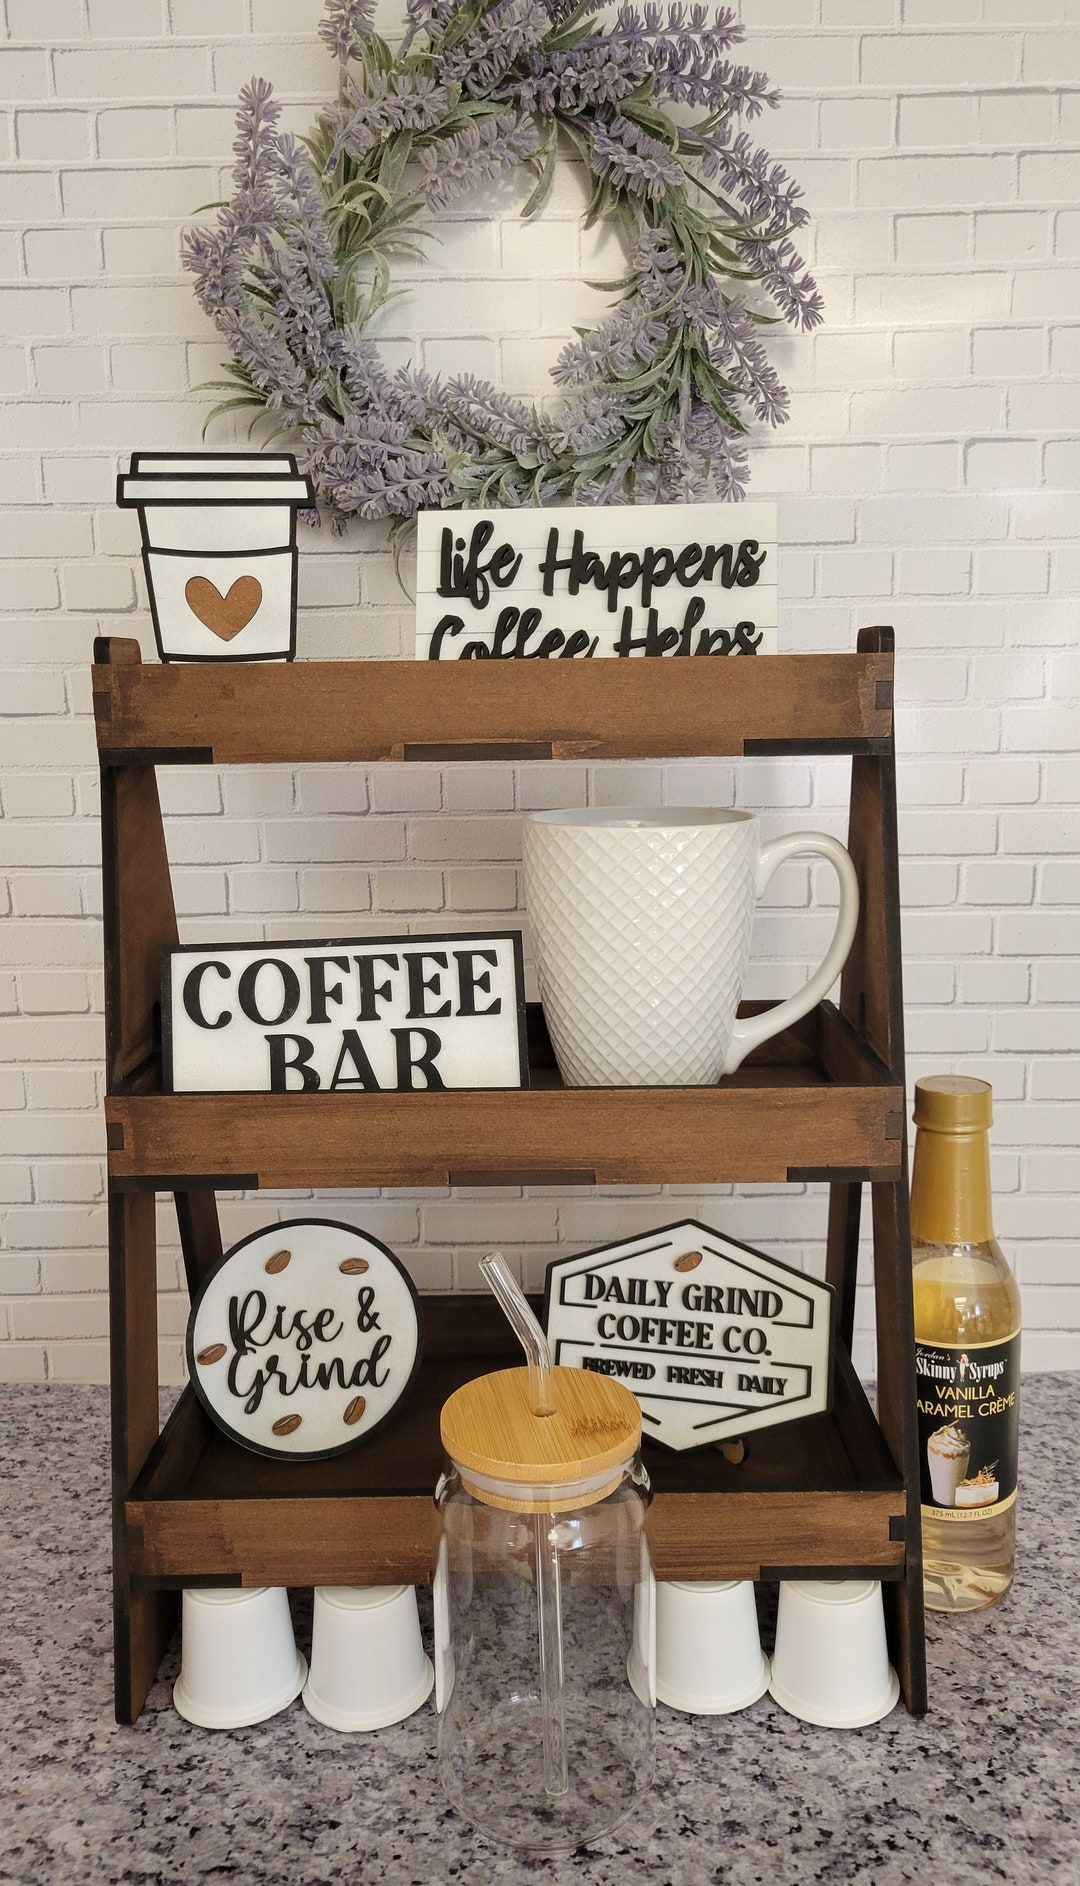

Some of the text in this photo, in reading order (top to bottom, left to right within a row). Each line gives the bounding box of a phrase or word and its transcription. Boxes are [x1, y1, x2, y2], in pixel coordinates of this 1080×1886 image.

[436, 520, 766, 612] Life Happens
[182, 949, 502, 1030] COFFEE
[264, 1027, 448, 1091] BAR
[584, 1273, 783, 1319] DAILY GRIND
[228, 1286, 382, 1353] Rise &
[597, 1313, 772, 1357] COFFEE CO.
[227, 1334, 392, 1414] Grind
[582, 1356, 788, 1396] BREWED FRESH DAILY
[915, 1347, 951, 1361] Jordan's
[915, 1356, 1004, 1383] Skinny Syrups
[916, 1391, 1015, 1418] ARAMEL CRÈME
[935, 1384, 995, 1401] VANILLA
[931, 1509, 944, 1517] 375
